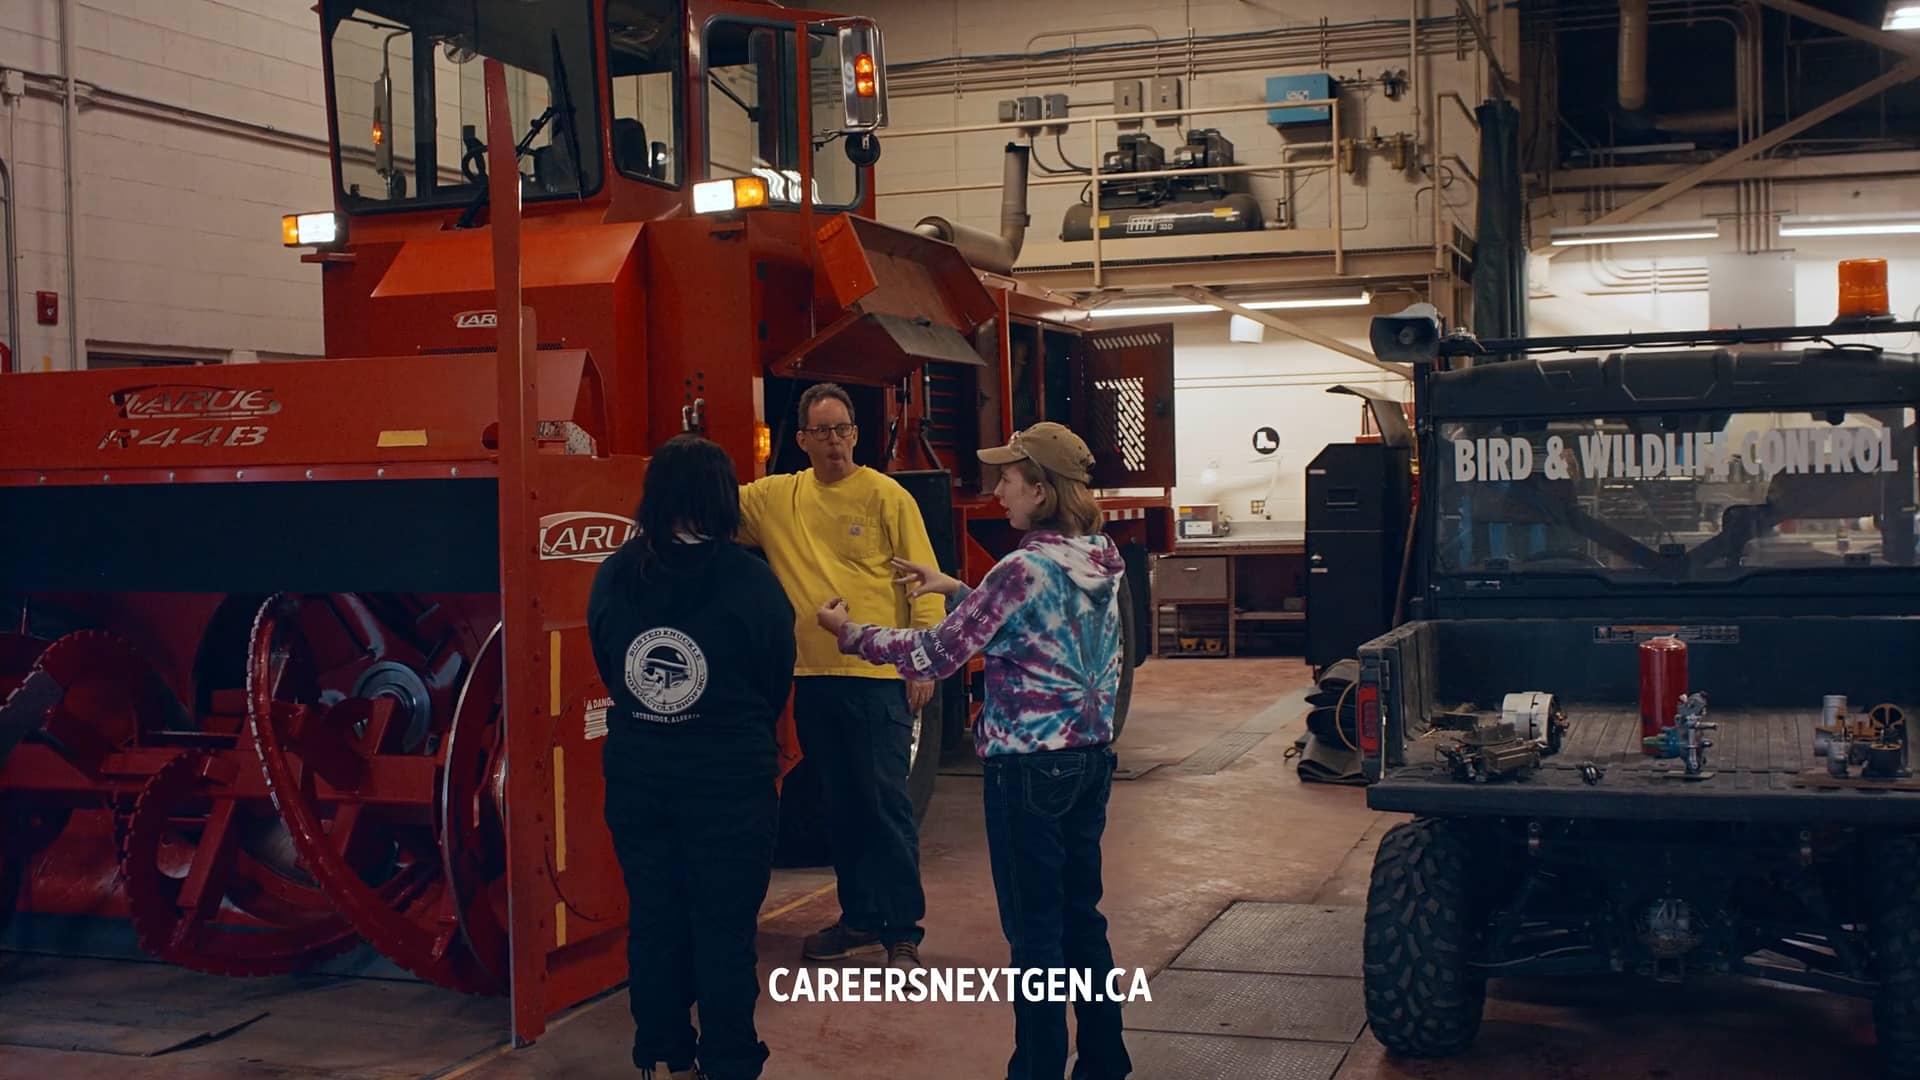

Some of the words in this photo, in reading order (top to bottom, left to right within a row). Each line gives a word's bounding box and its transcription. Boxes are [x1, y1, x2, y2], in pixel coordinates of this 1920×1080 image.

[457, 314, 496, 328] LAR
[98, 426, 267, 448] R44B
[1454, 438, 1533, 481] BIRD
[1544, 435, 1571, 480] &
[1743, 427, 1899, 474] CONTROL
[629, 630, 661, 657] BUSTED
[663, 631, 703, 661] KNUCKLE
[675, 691, 699, 709] SHOP
